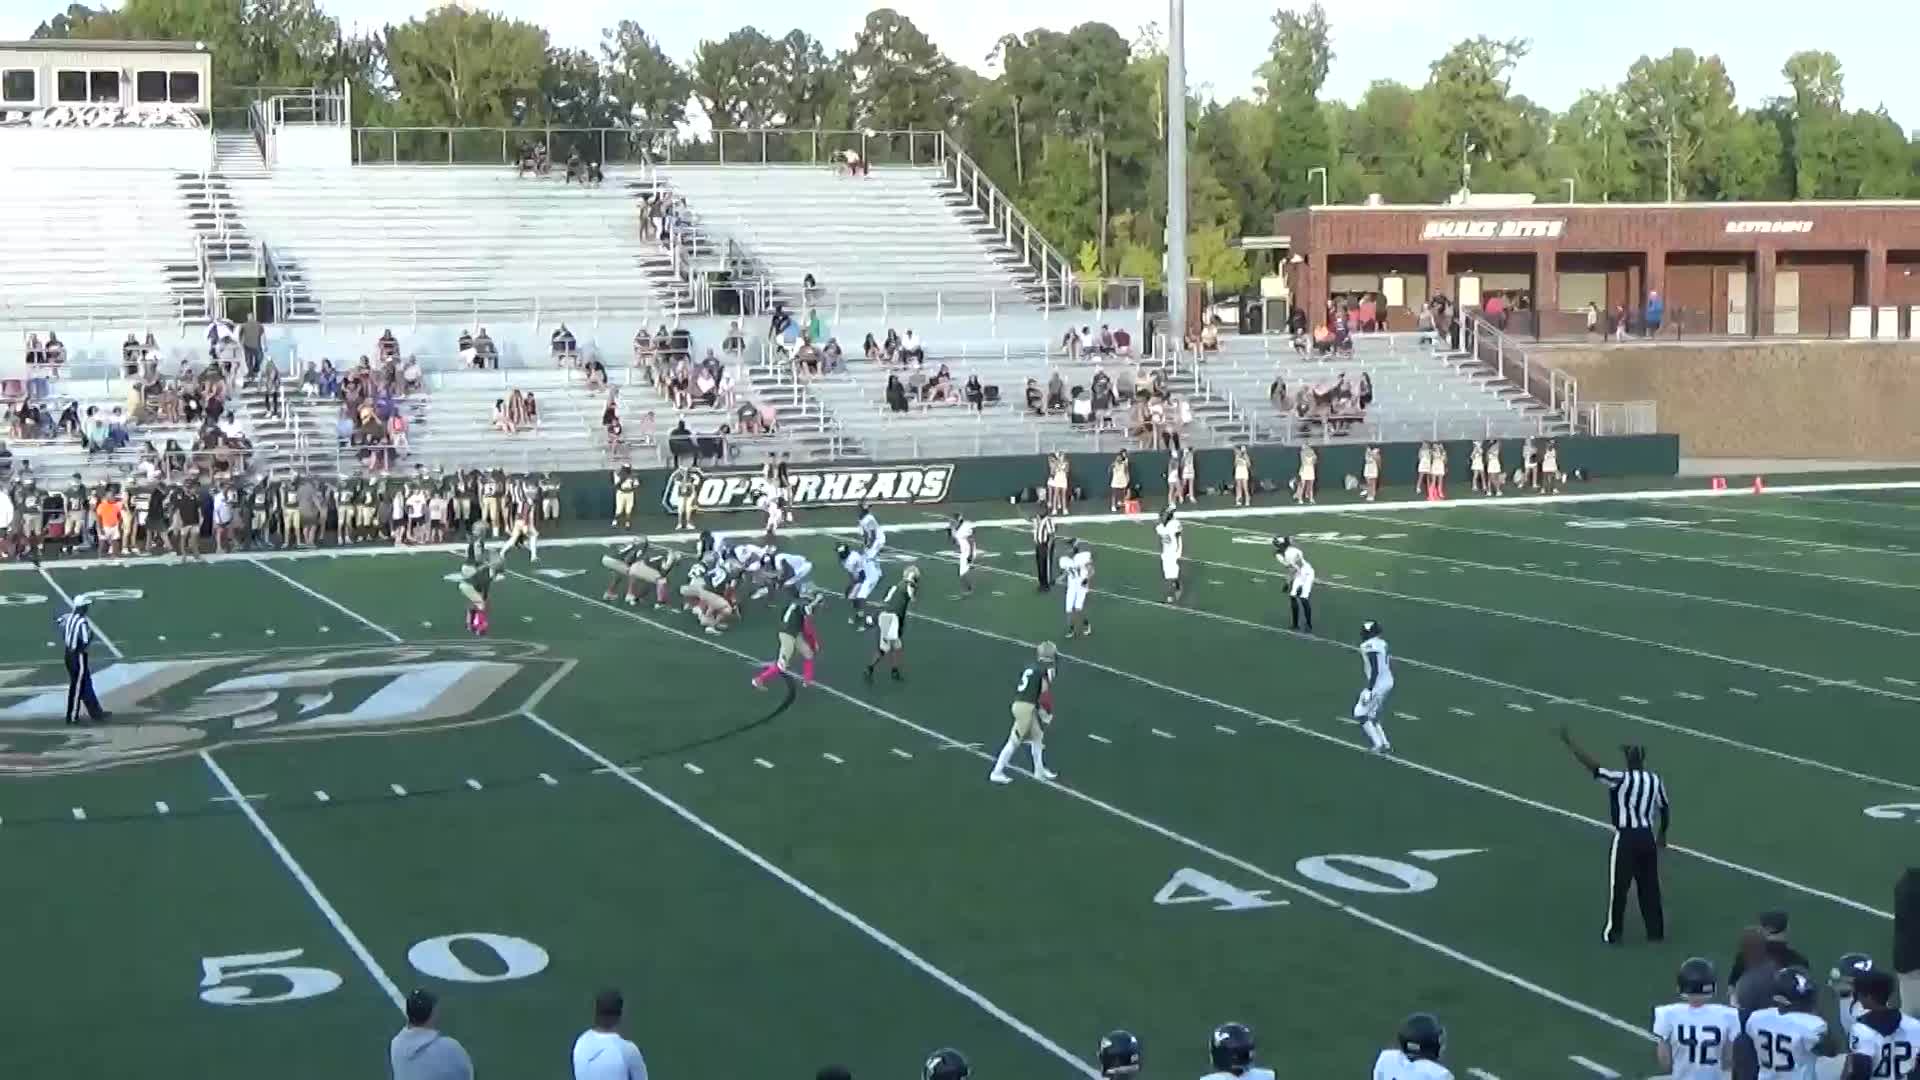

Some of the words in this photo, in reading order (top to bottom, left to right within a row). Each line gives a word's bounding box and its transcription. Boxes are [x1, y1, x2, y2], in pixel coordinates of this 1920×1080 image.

[1677, 1023, 1722, 1065] 42
[1757, 1029, 1796, 1072] 35
[1873, 1040, 1913, 1080] 82
